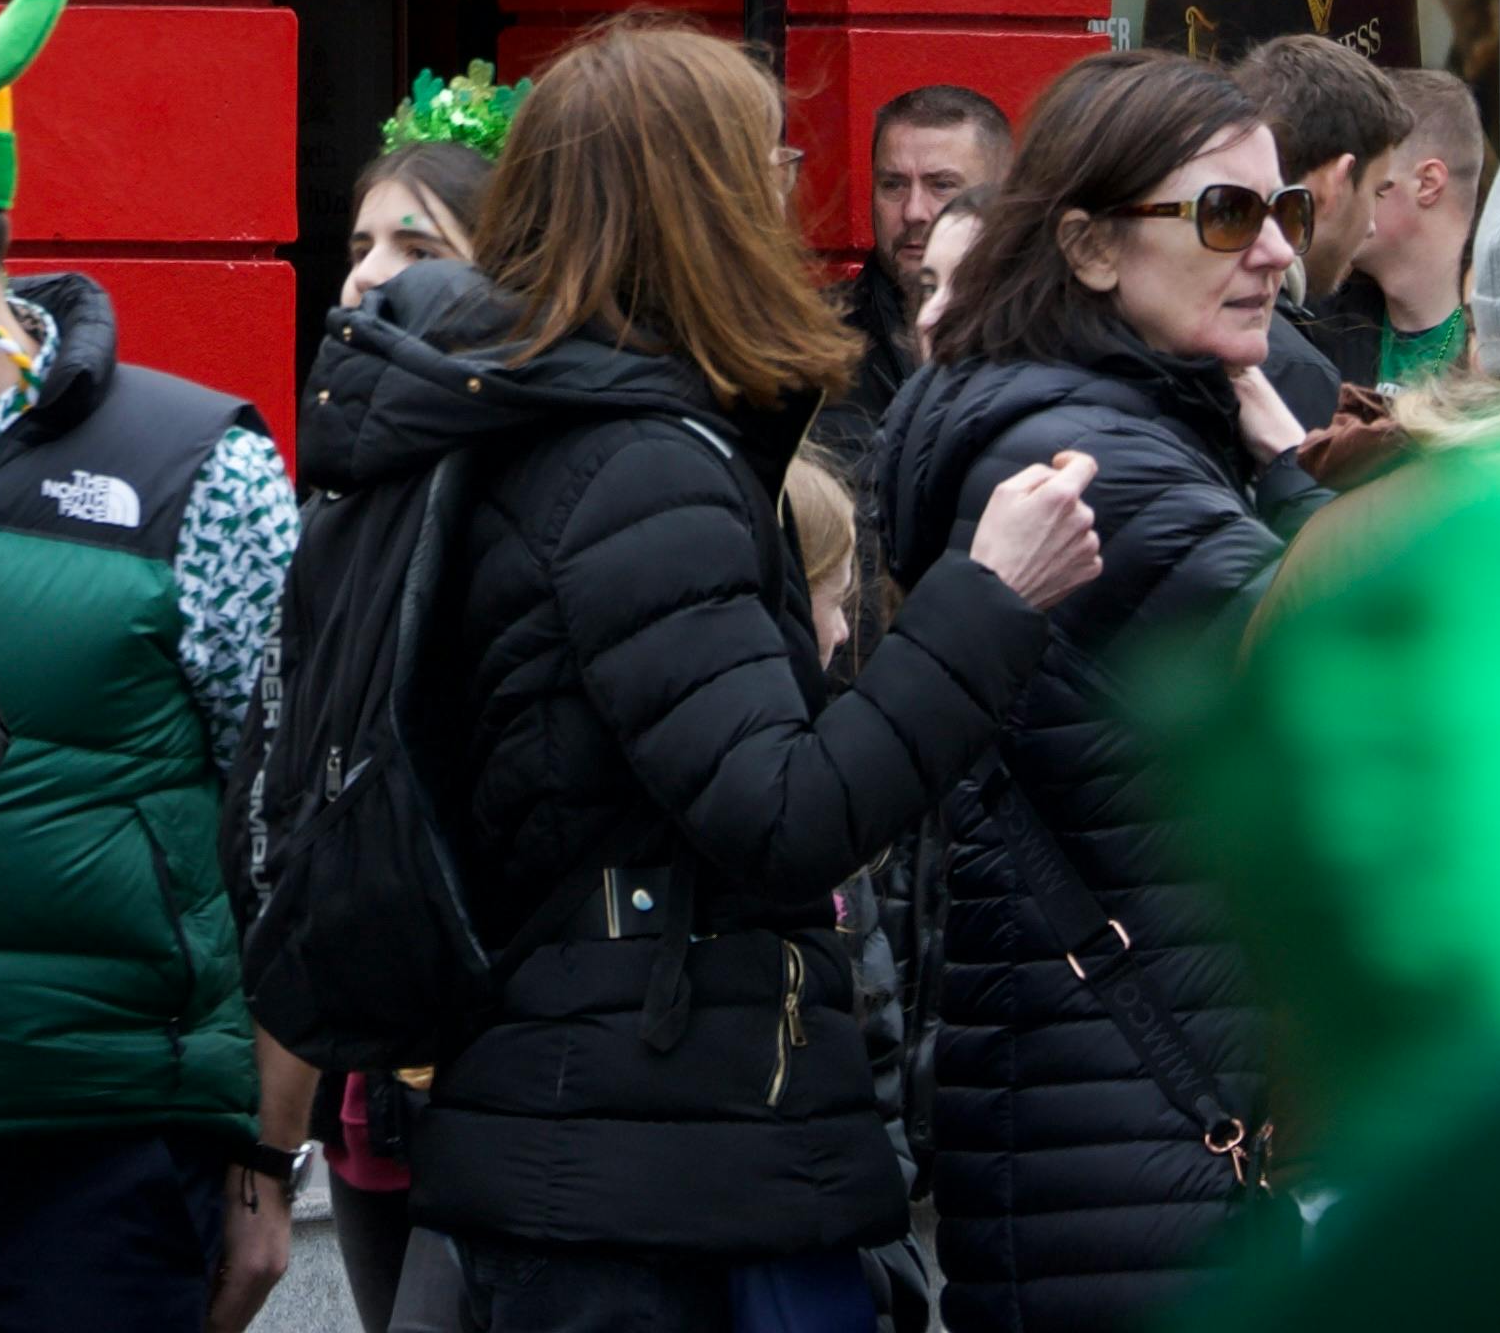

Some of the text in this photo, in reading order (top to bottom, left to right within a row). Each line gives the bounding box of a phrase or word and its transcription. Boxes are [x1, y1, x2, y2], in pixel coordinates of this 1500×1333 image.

[41, 479, 110, 507] NORTH
[72, 469, 110, 491] THE
[58, 497, 110, 523] FACE
